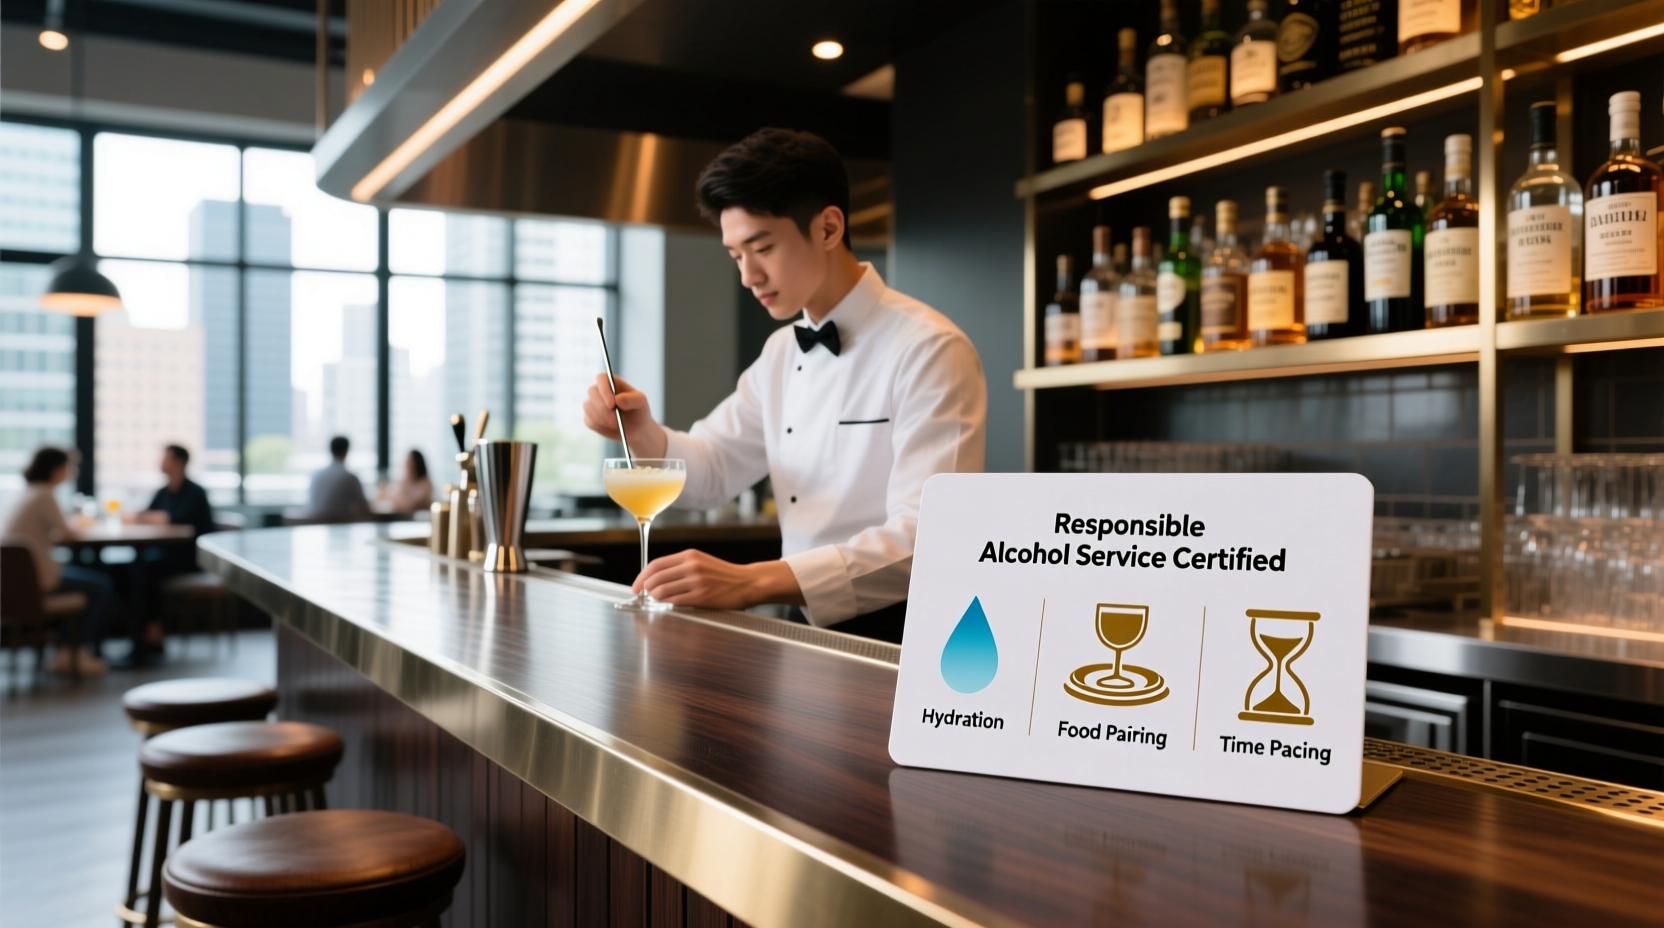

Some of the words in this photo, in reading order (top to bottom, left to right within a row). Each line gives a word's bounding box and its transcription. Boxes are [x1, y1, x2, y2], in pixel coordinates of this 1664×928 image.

[1054, 512, 1206, 542] Responsible
[978, 540, 1071, 566] Alcohol
[1075, 543, 1167, 569] Service
[1172, 546, 1287, 572] Certified
[921, 708, 1004, 730] Hydration
[1057, 720, 1102, 740] Food
[1105, 724, 1168, 751] Pairing
[1219, 735, 1265, 756] Time
[1270, 739, 1332, 766] Pacing
